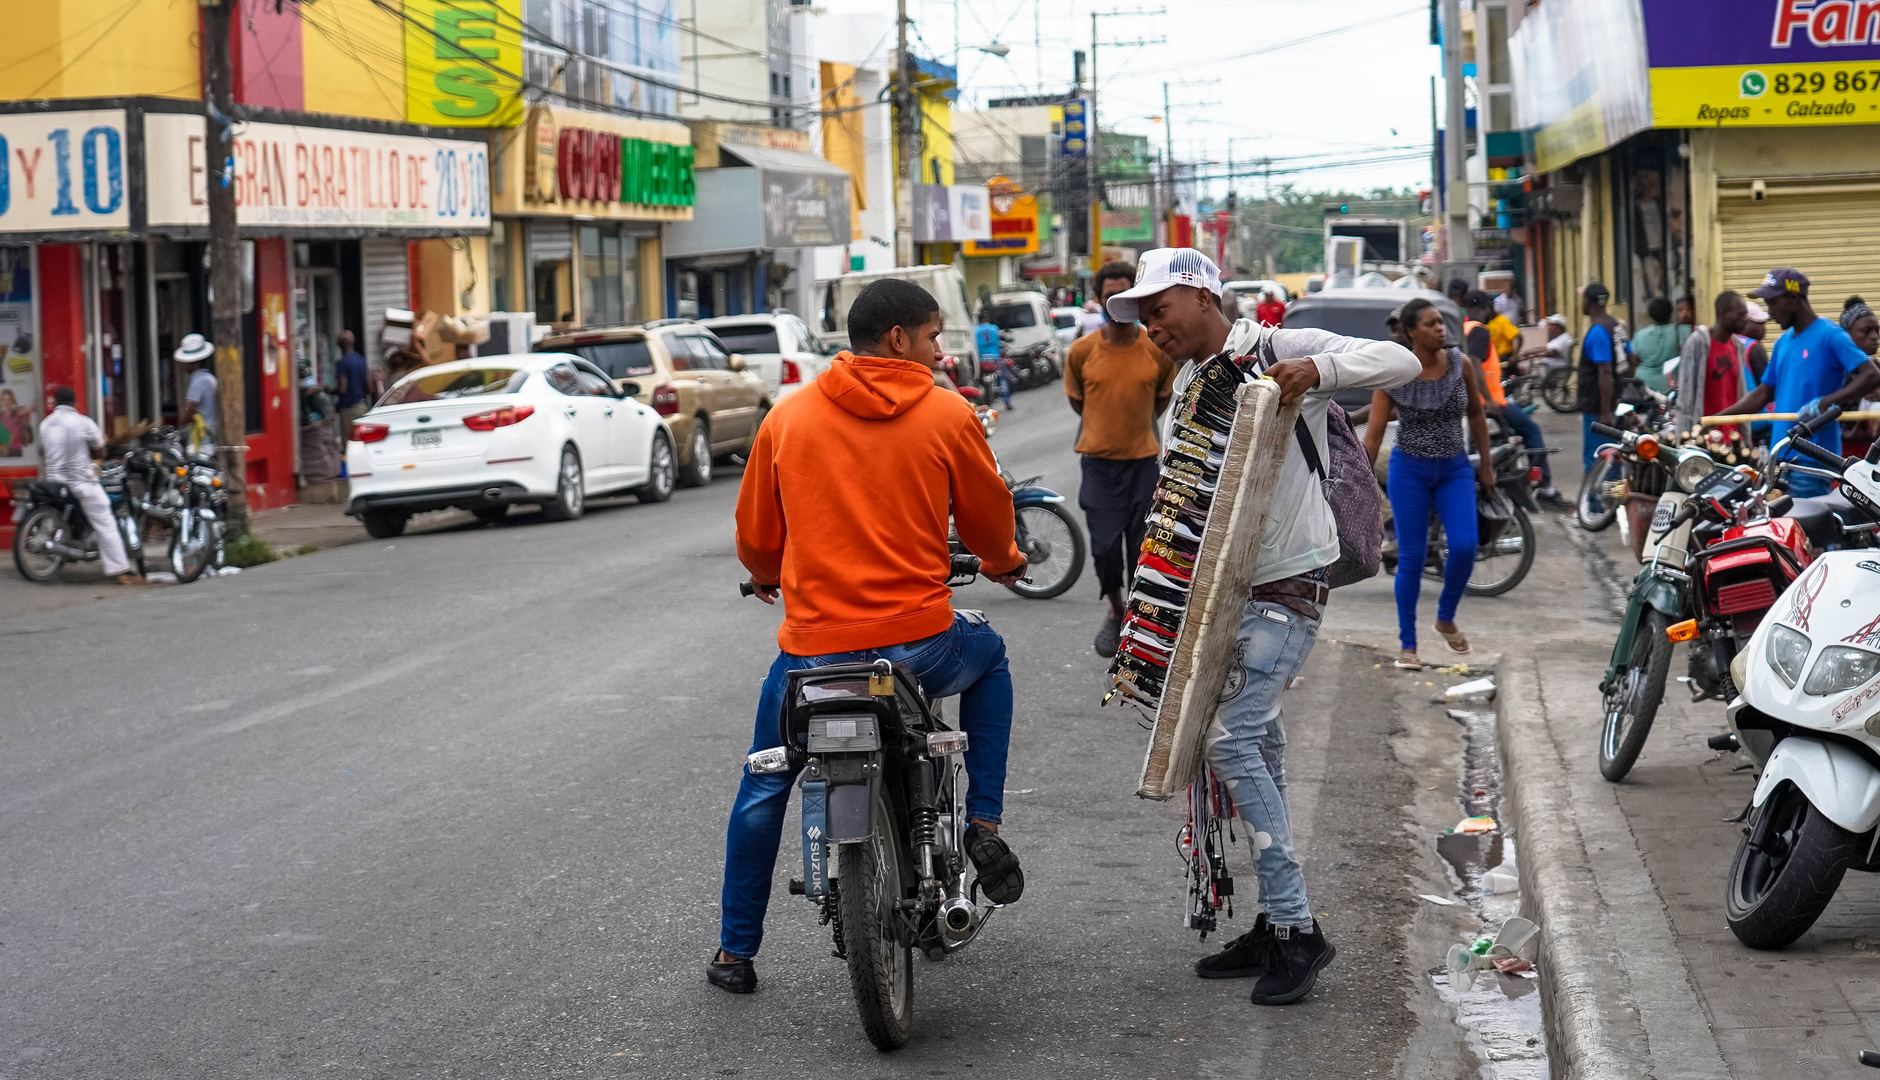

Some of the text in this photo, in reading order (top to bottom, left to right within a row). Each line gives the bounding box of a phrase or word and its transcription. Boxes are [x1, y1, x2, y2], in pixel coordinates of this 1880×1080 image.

[1774, 72, 1825, 94] 829
[1697, 103, 1750, 127] Ropas
[1786, 99, 1855, 117] Calzado
[47, 126, 122, 215] 10
[232, 138, 287, 207] GRAN
[295, 143, 400, 208] BARATILLO
[407, 154, 428, 209] DE
[436, 149, 459, 216] 20
[468, 153, 486, 217] 10
[810, 841, 823, 895] SUZUKI
